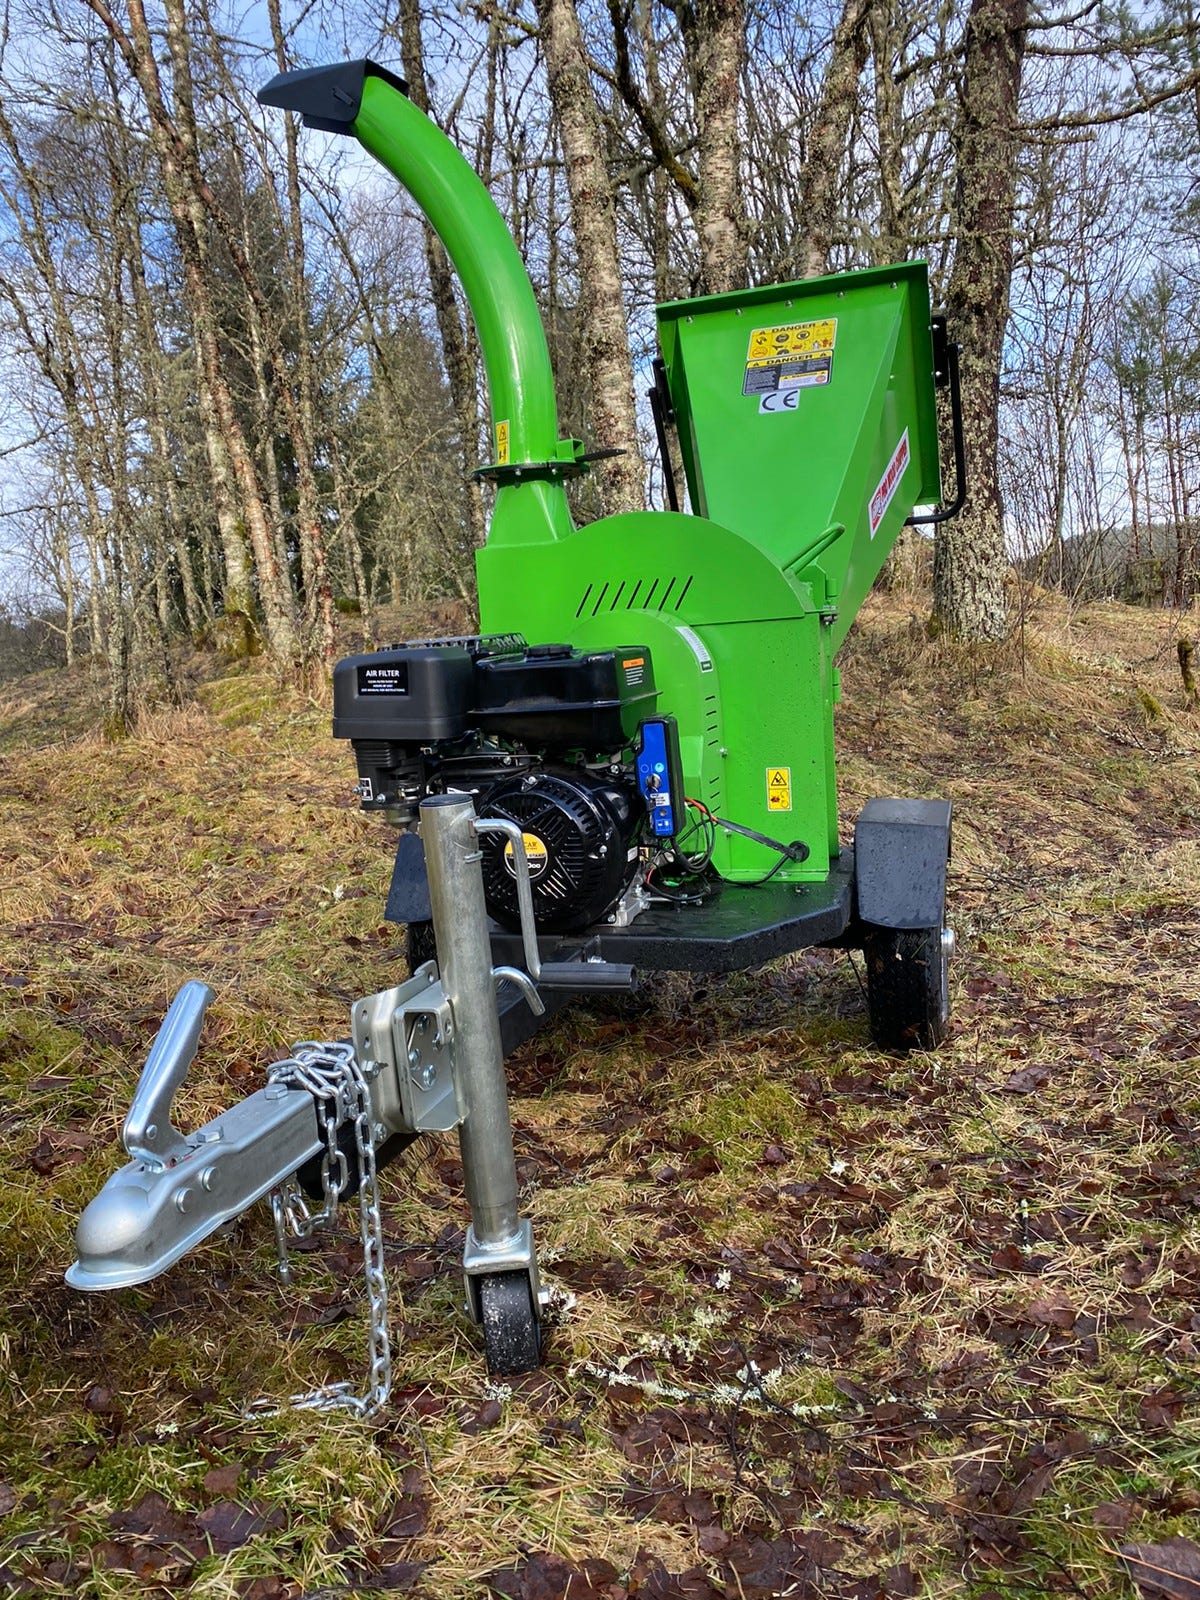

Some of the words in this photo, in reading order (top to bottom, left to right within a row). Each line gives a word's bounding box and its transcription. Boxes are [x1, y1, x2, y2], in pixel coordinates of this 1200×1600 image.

[771, 322, 817, 334] DANGER
[766, 354, 813, 365] DANGER
[762, 390, 798, 411] CE
[366, 669, 378, 677] AIR
[378, 669, 400, 677] FILTER
